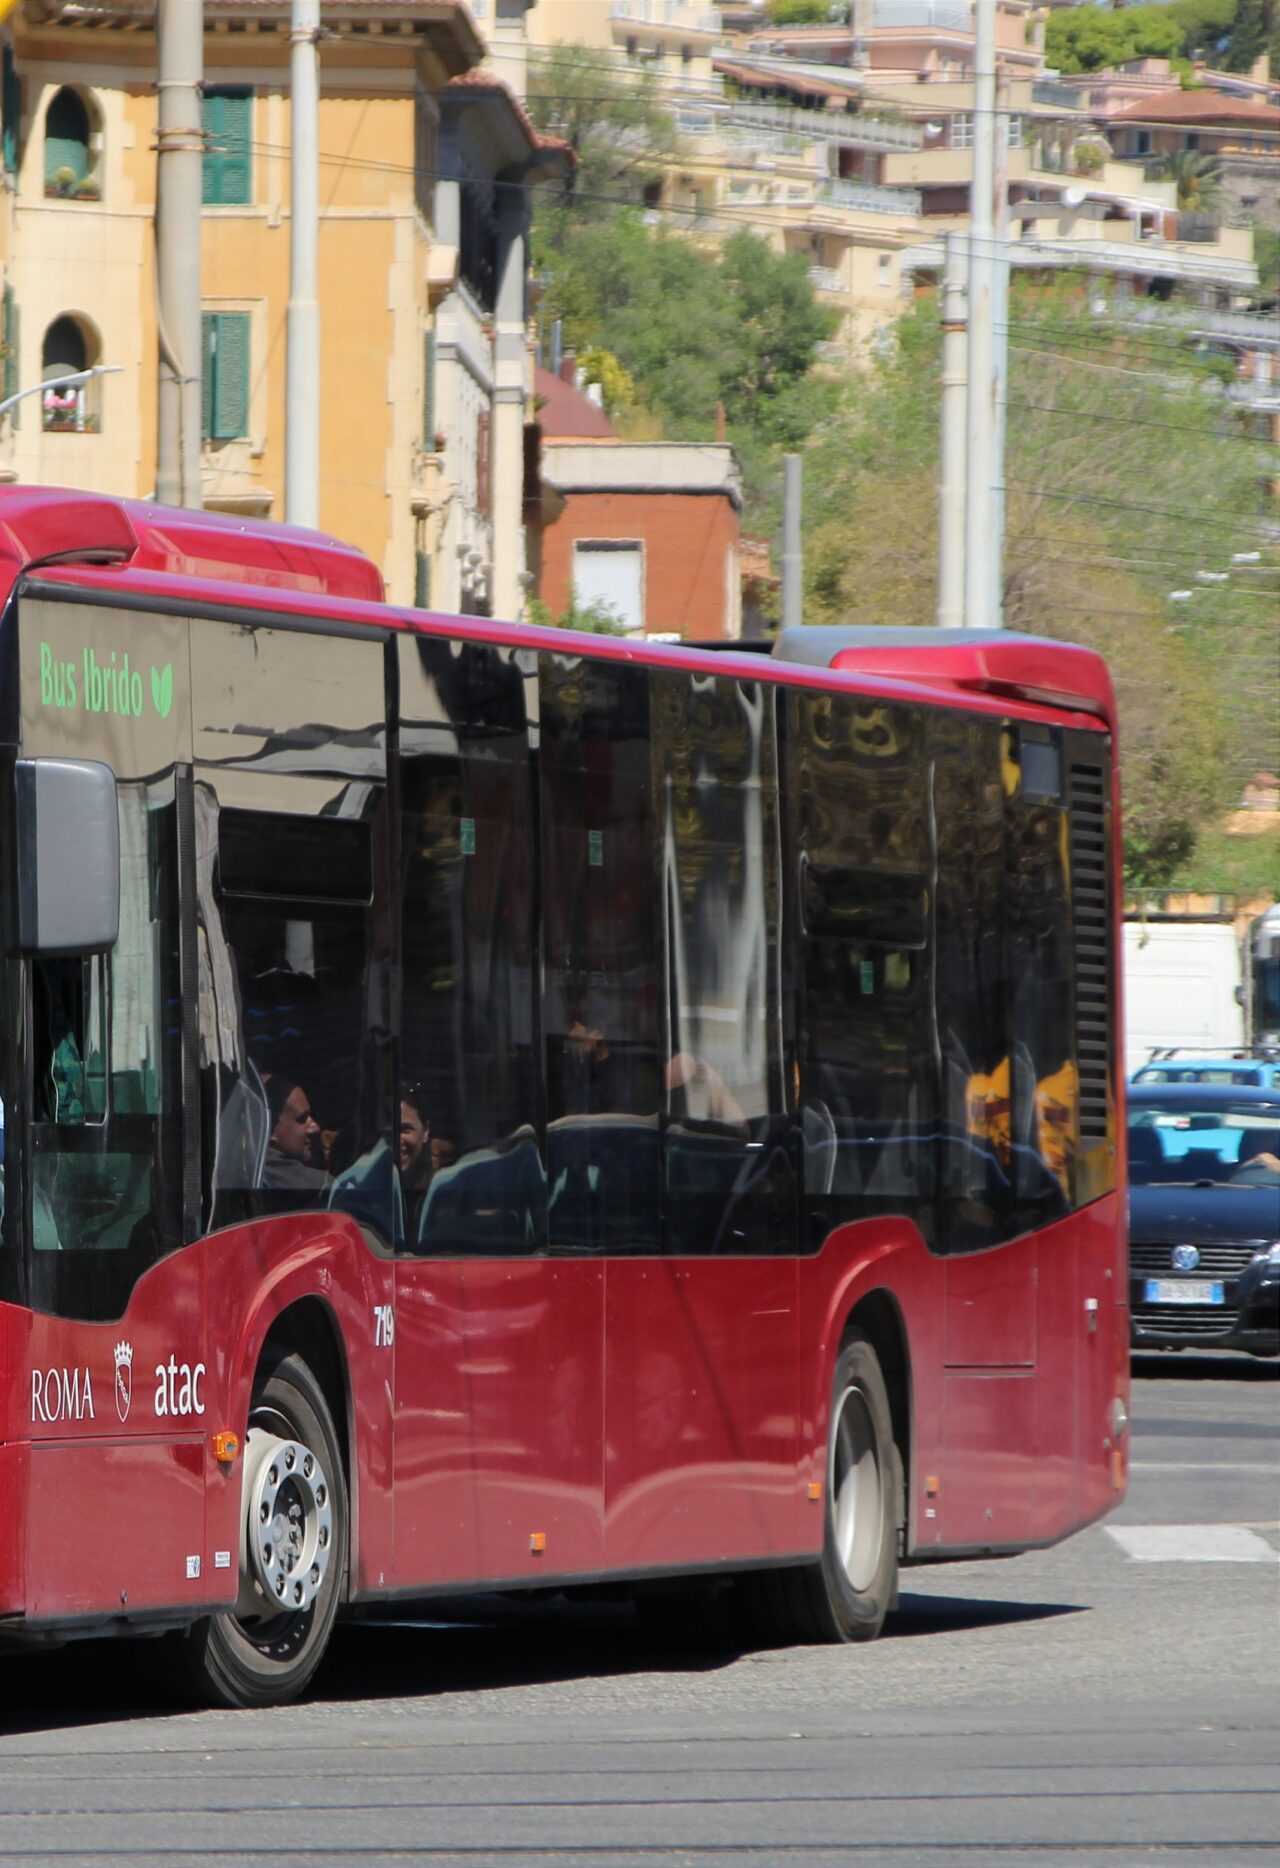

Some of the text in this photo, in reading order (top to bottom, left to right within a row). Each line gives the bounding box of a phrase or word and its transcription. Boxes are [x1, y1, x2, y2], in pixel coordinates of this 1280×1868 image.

[39, 641, 145, 717] Bus Ibrido
[373, 1305, 395, 1347] 719
[31, 1367, 96, 1423] ROMA
[154, 1353, 207, 1417] atac
